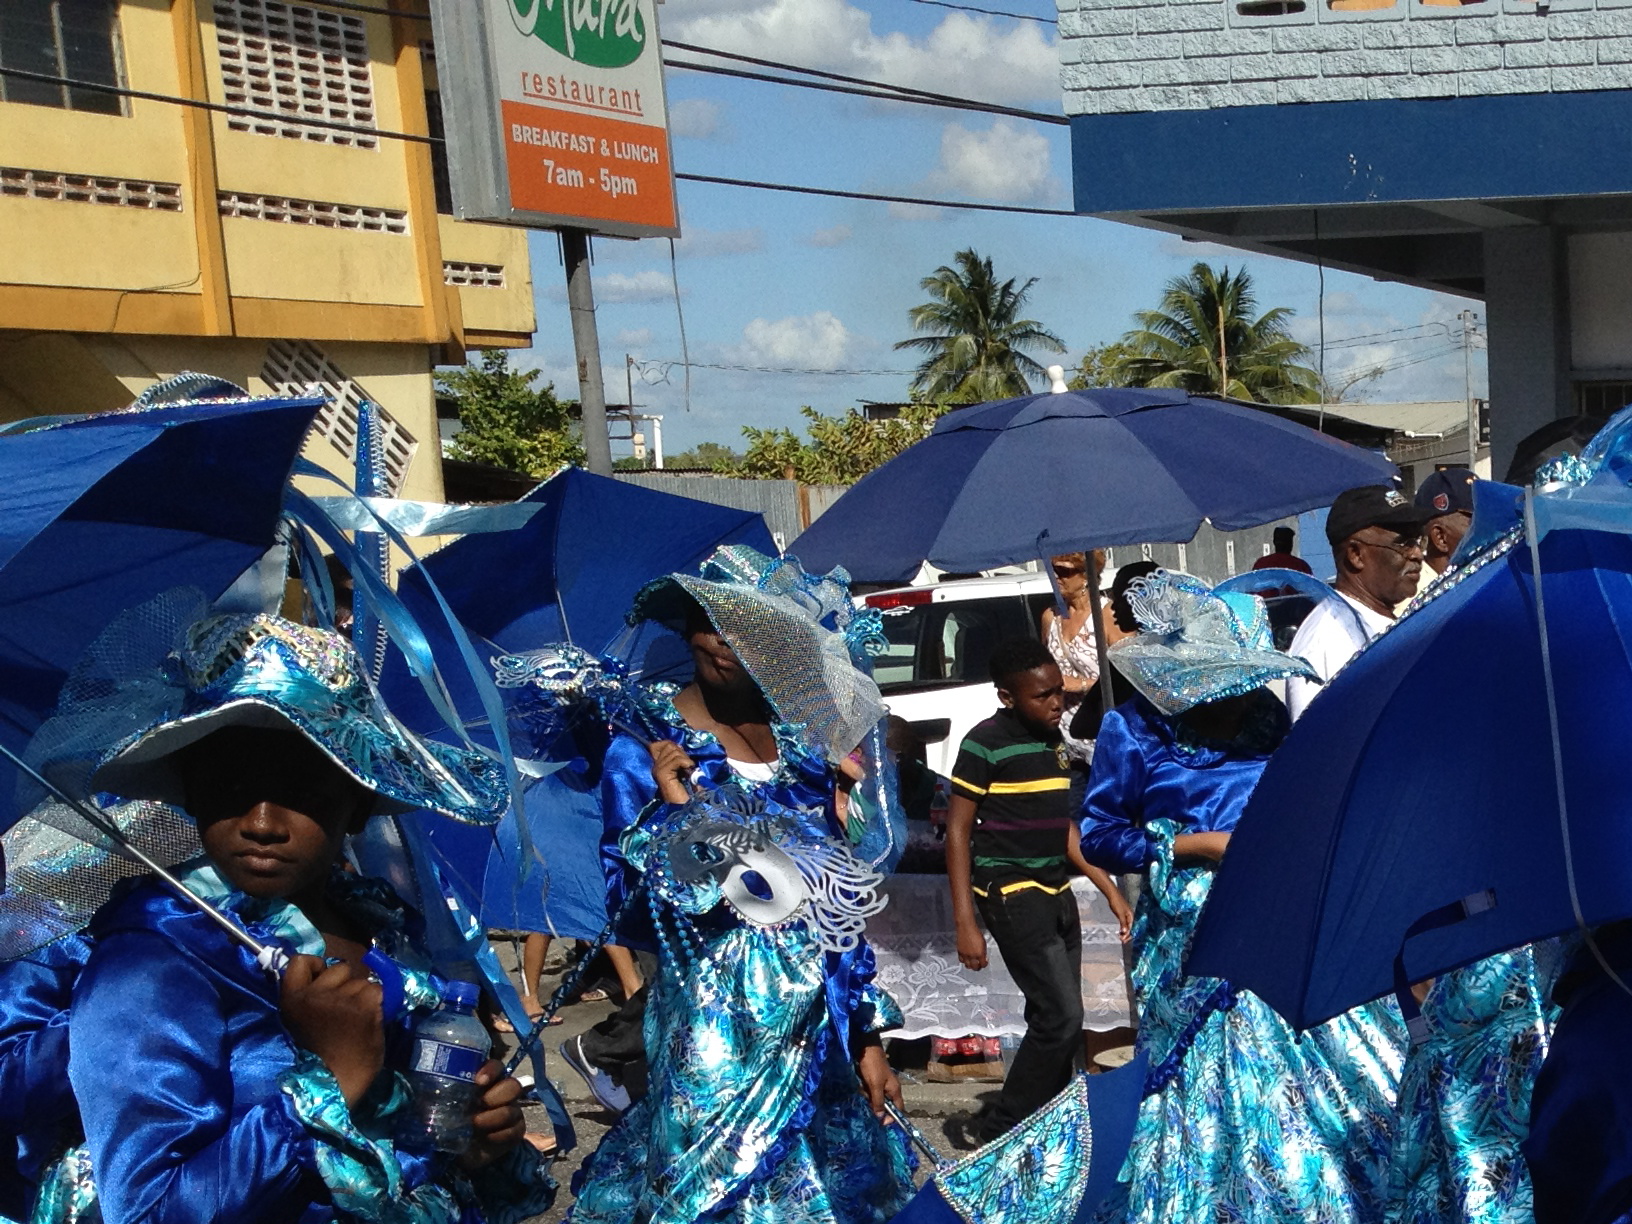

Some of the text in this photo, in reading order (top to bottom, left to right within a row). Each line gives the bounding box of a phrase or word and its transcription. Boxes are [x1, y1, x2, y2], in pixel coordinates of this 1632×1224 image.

[521, 71, 642, 111] restaurant
[512, 124, 658, 164] BREAKFAST & LUNCH
[543, 159, 584, 187] 7am
[600, 168, 638, 198] 5pm
